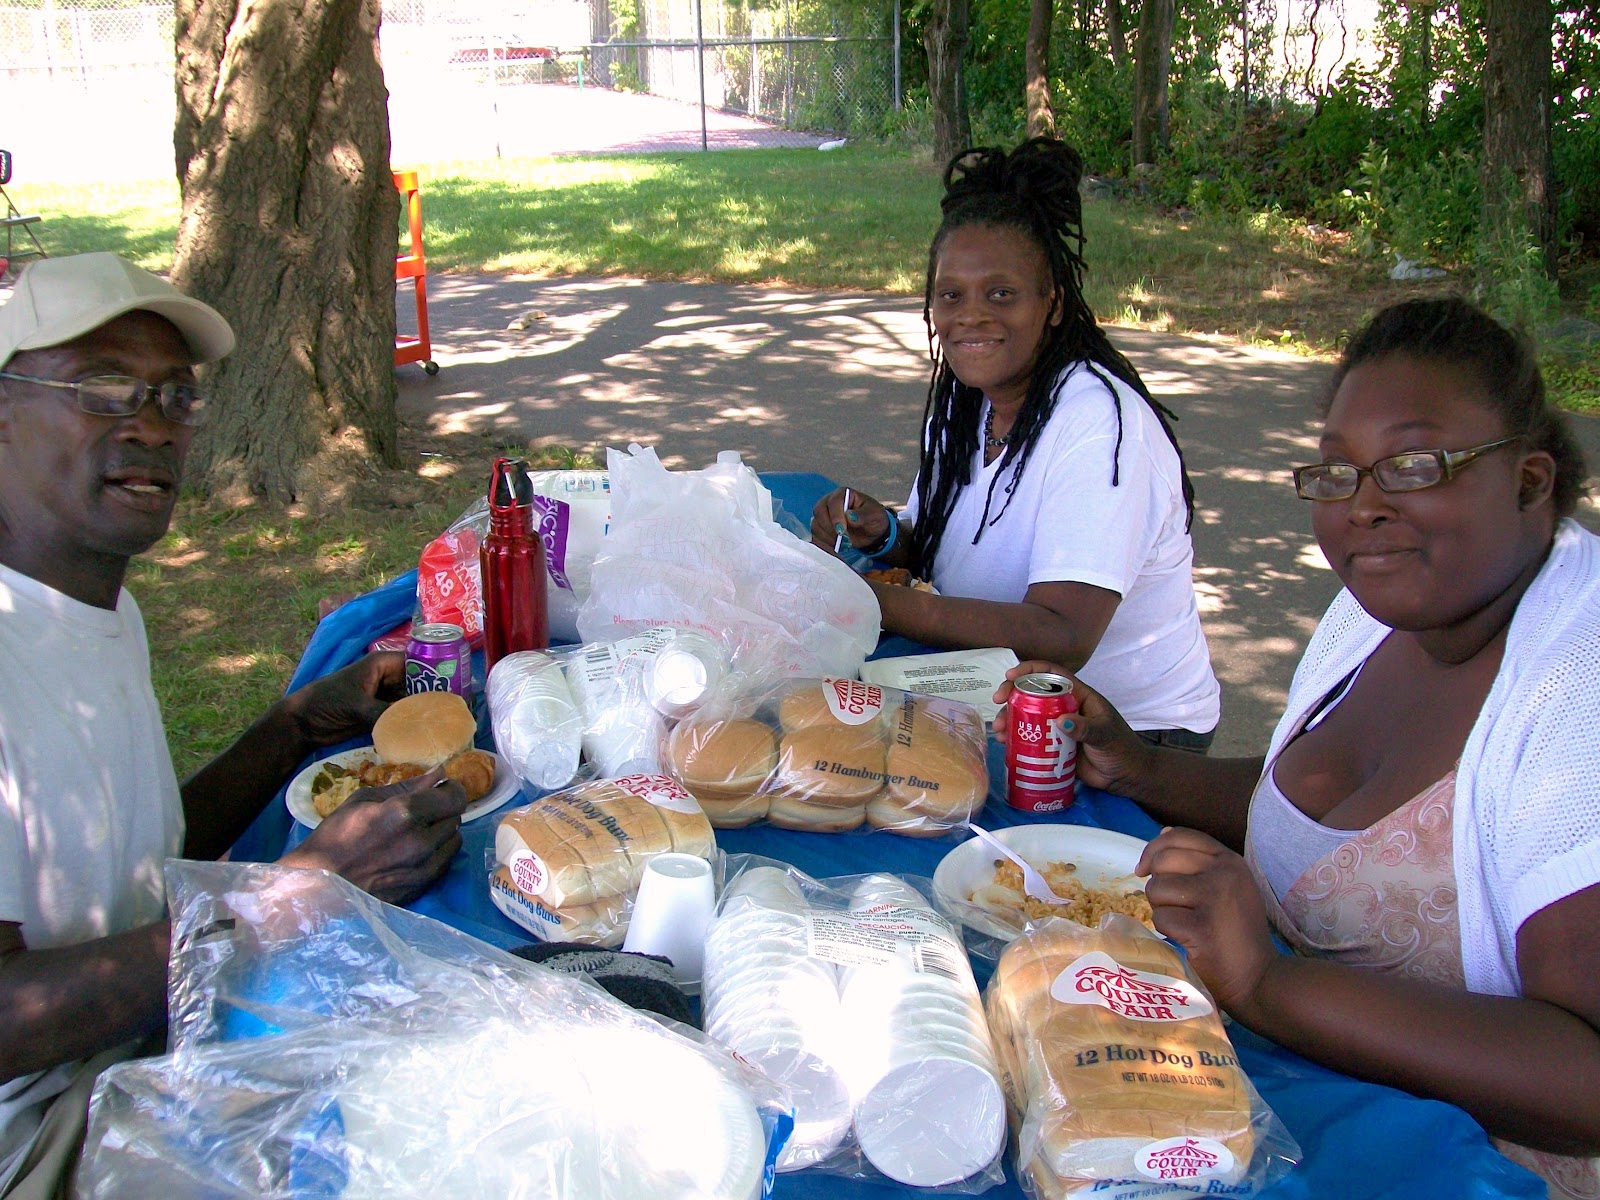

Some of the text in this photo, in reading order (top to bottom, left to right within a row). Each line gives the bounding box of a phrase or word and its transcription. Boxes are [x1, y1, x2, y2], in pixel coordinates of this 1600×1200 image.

[435, 571, 454, 597] 48
[897, 733, 912, 748] 12
[813, 760, 940, 791] 12 Hamburger Buns
[575, 801, 602, 820] Dog
[514, 863, 541, 887] COUNTY
[517, 876, 534, 893] FAIR
[492, 875, 501, 890] 12
[502, 880, 516, 900] Hot
[518, 890, 534, 914] Dog
[536, 903, 561, 925] Buns
[1076, 977, 1190, 1006] COUNTY
[1106, 999, 1177, 1019] FAIR
[1075, 1044, 1241, 1069] 12 Hot Dog Bun
[1121, 1072, 1136, 1082] NET
[1136, 1072, 1148, 1082] WT
[1150, 1074, 1159, 1083] 18
[1160, 1073, 1171, 1083] OZ
[1146, 1158, 1218, 1169] COUNTY
[1158, 1168, 1198, 1179] FAIR
